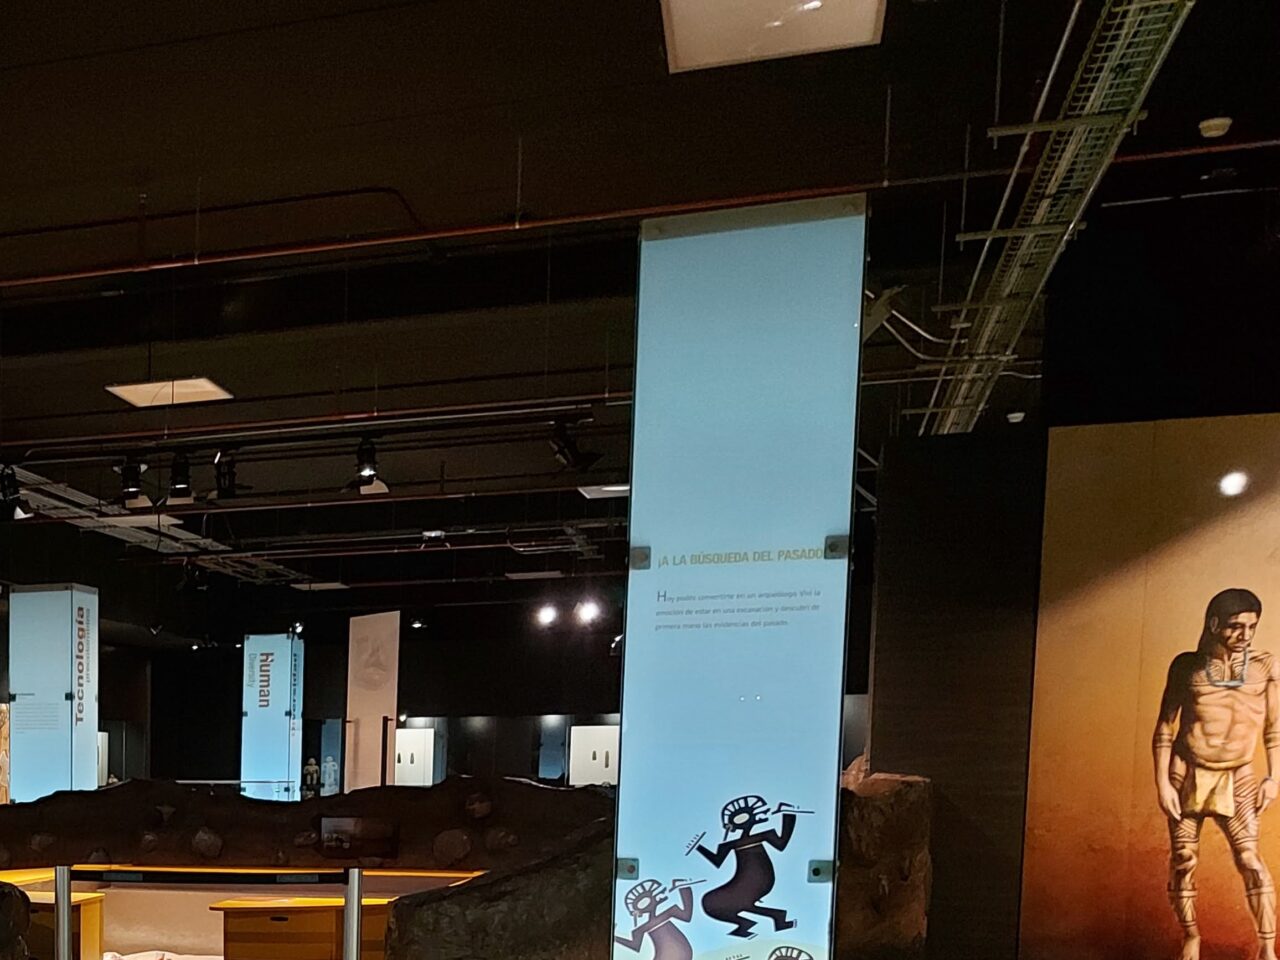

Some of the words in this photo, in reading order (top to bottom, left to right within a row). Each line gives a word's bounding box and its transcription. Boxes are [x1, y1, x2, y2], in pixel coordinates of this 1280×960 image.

[672, 554, 686, 566] LA
[753, 550, 773, 562] DEL
[75, 606, 85, 726] Tecnología
[258, 652, 275, 708] Human
